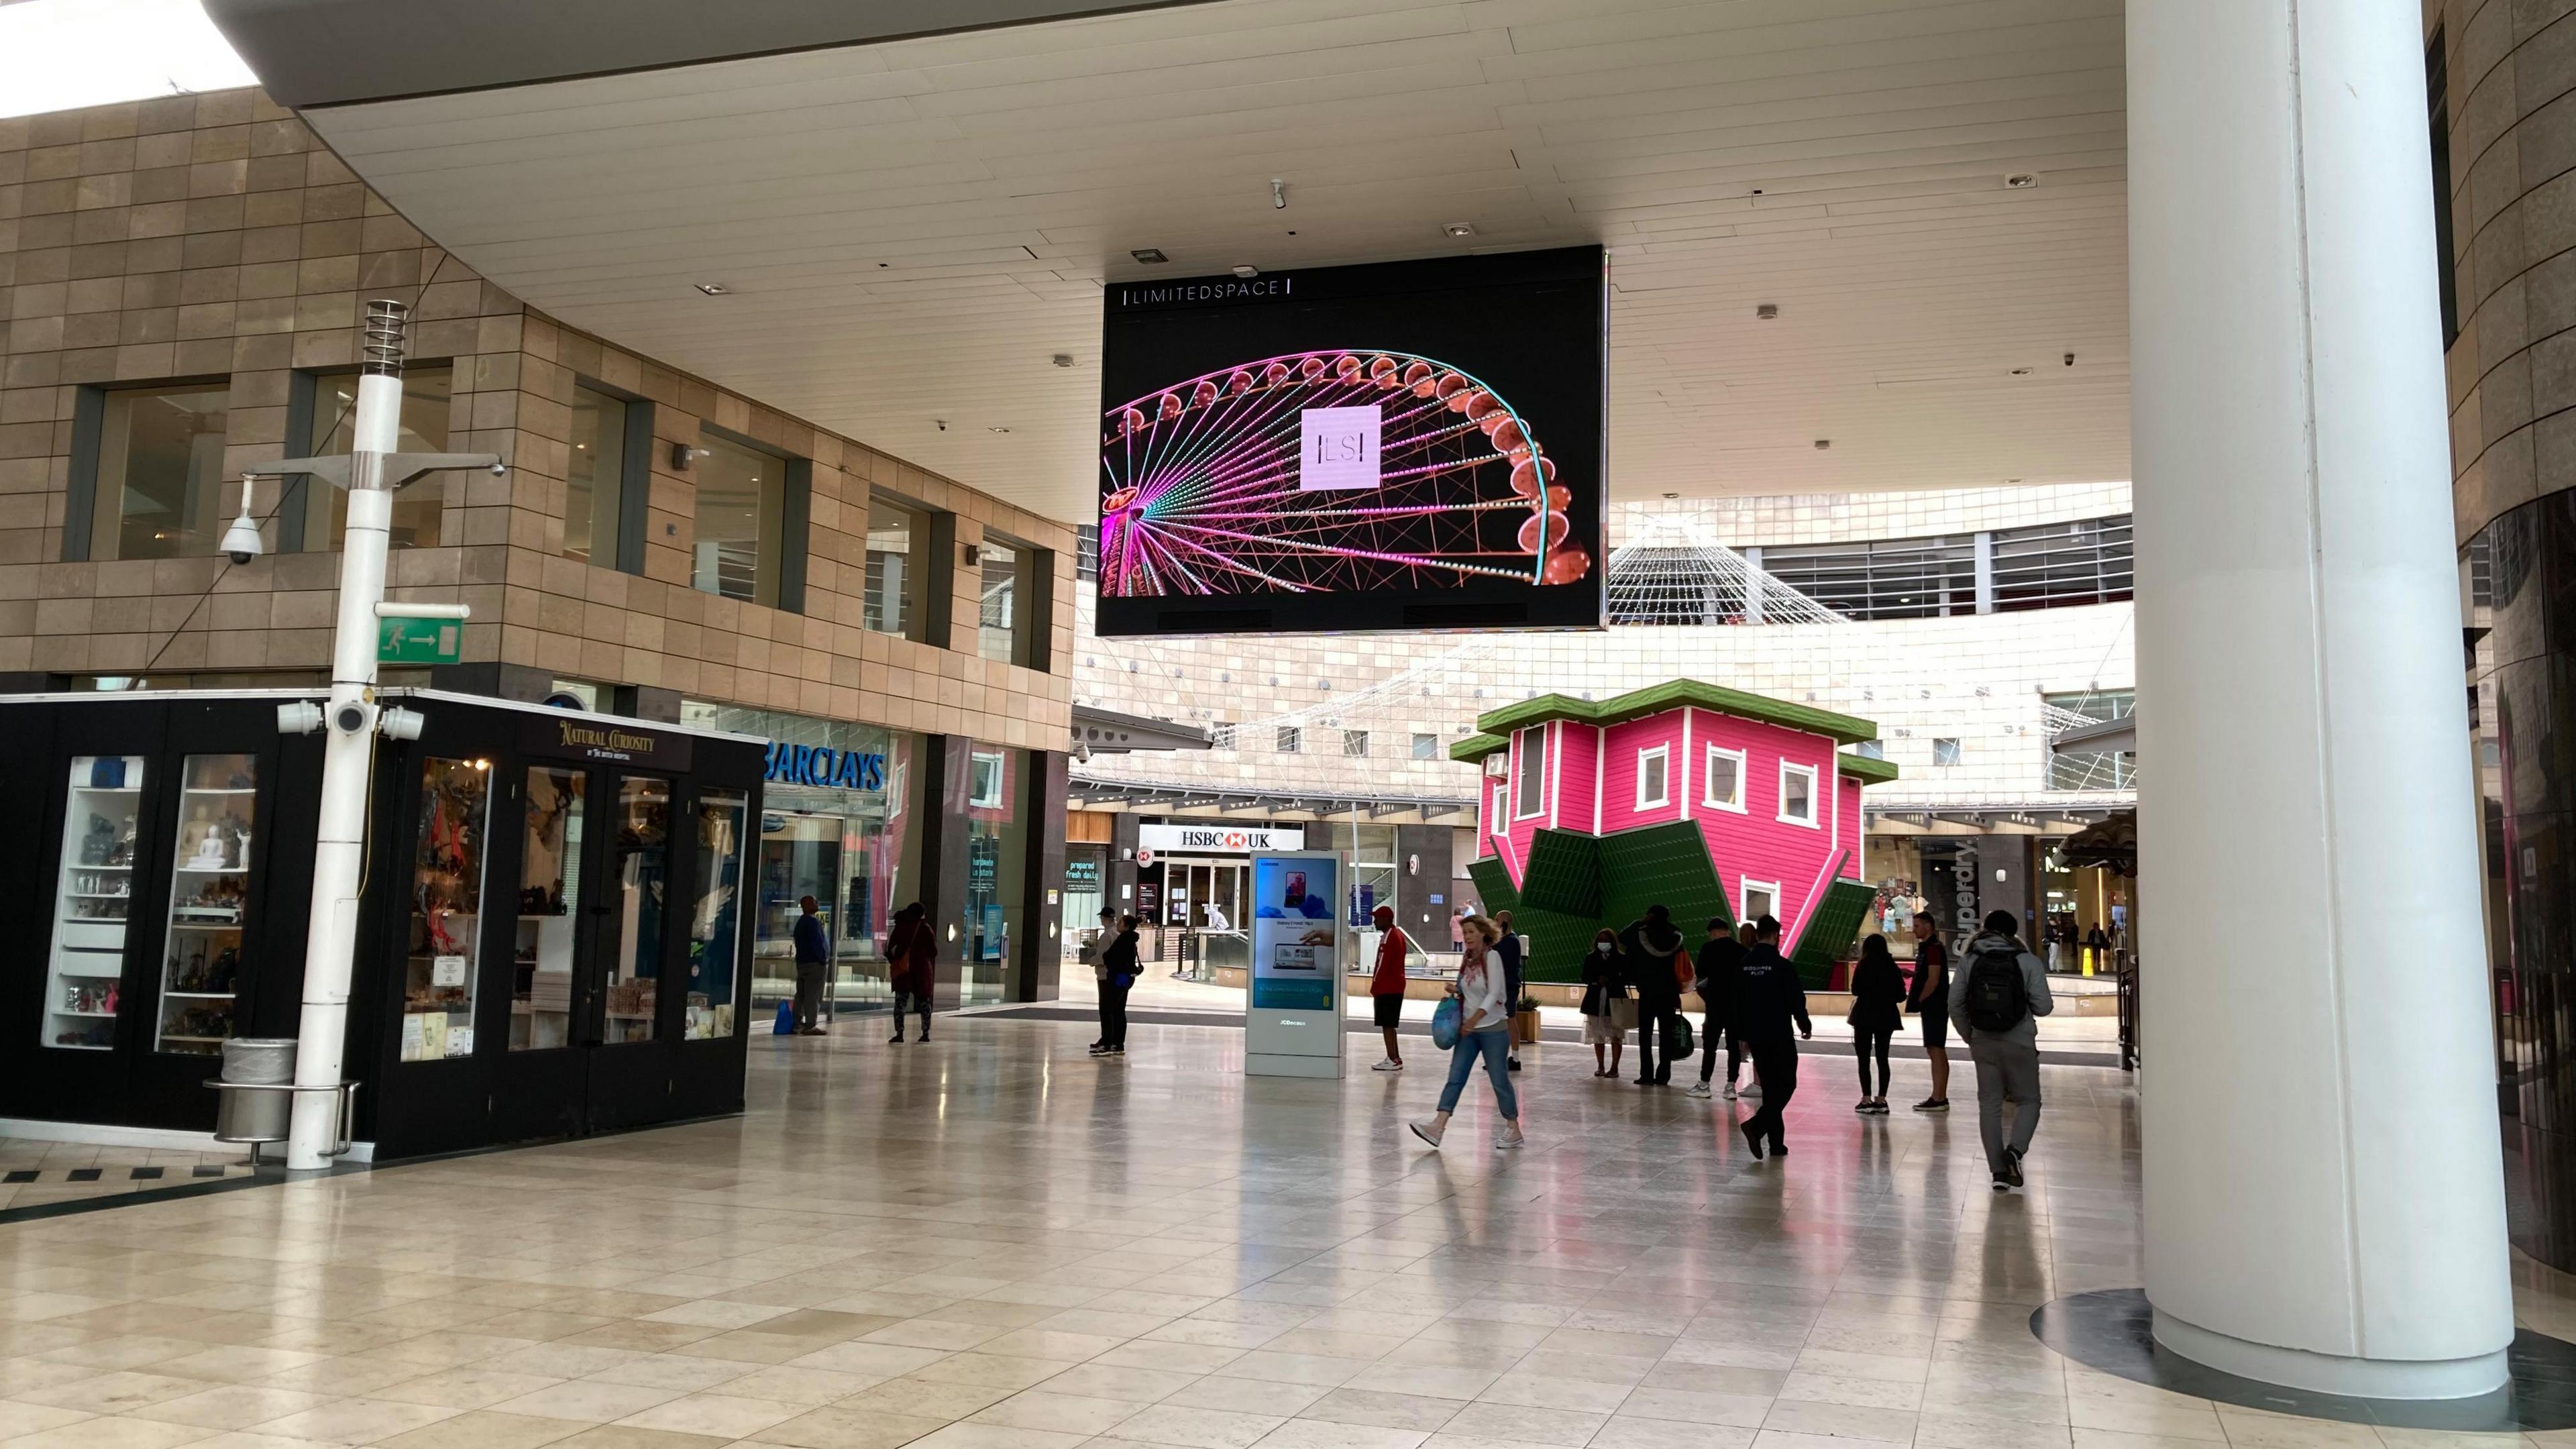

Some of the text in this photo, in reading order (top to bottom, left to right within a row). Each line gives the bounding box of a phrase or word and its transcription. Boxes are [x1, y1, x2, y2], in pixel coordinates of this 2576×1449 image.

[1181, 831, 1271, 848] HSBC UK
[1070, 861, 1095, 871] prepared
[1066, 870, 1098, 881] fresh daily
